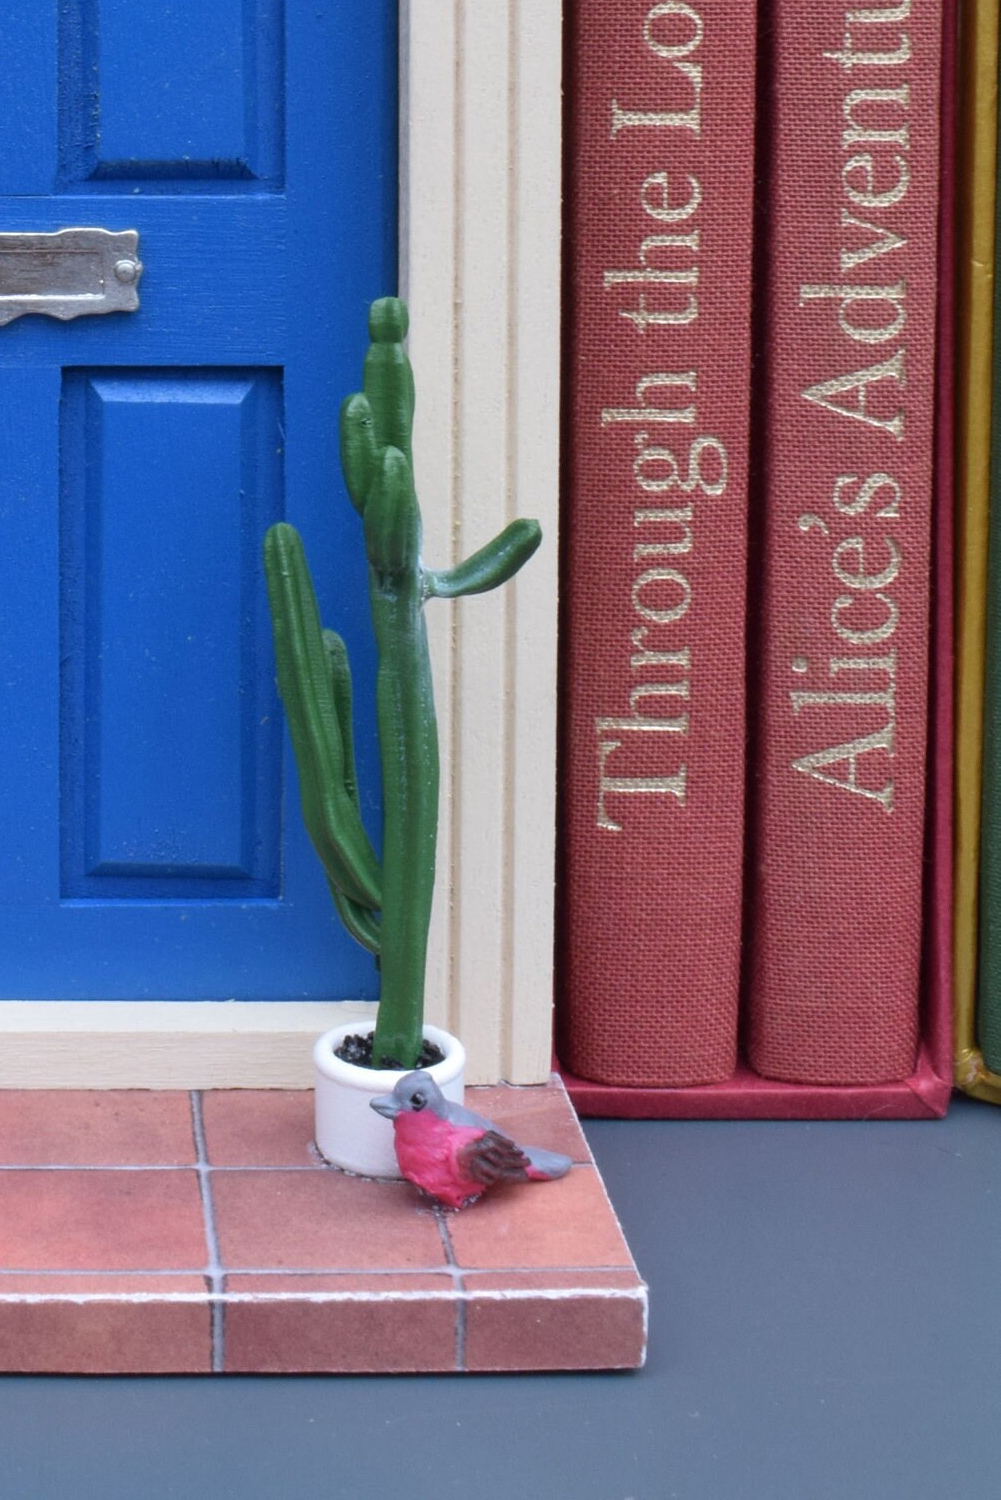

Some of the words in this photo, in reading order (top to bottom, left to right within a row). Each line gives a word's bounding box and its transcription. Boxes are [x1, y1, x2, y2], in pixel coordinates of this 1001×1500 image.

[602, 170, 702, 330] the
[595, 369, 727, 832] Through
[790, 472, 902, 812] Alice's
